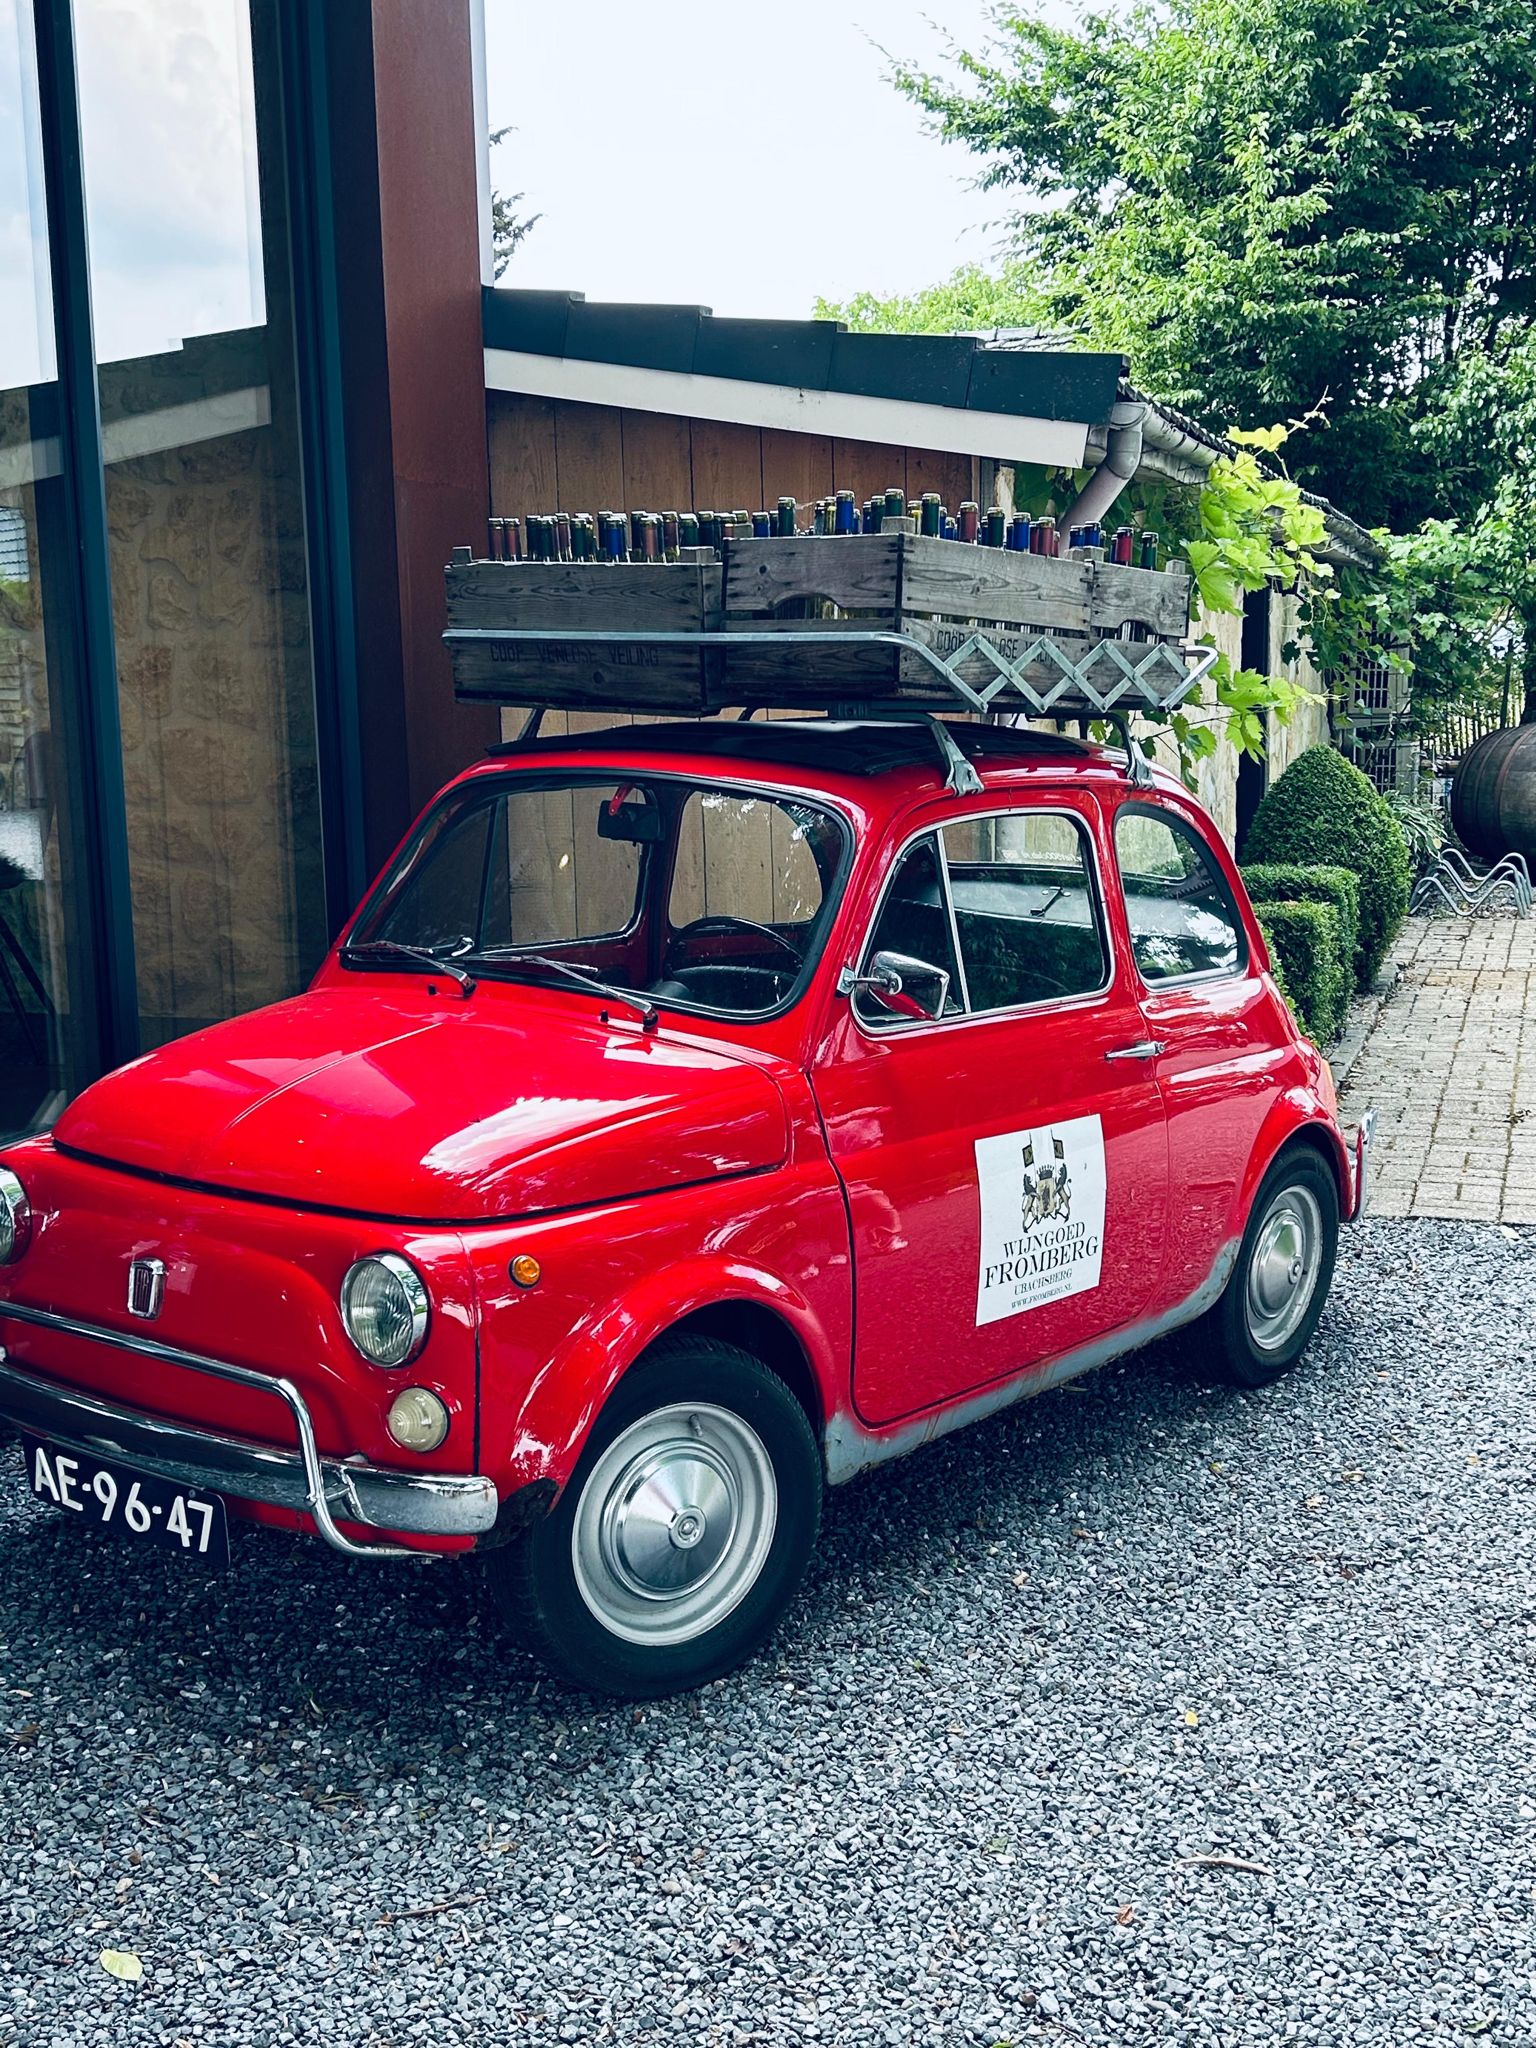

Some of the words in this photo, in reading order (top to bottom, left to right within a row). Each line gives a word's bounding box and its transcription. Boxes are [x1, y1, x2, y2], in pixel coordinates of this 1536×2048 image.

[609, 646, 658, 666] VEILING
[1003, 1221, 1085, 1258] WIJNGOED
[983, 1236, 1099, 1289] FROMBERG
[1014, 1267, 1073, 1296] UBACHSBERG
[35, 1447, 213, 1553] AE-96-47
